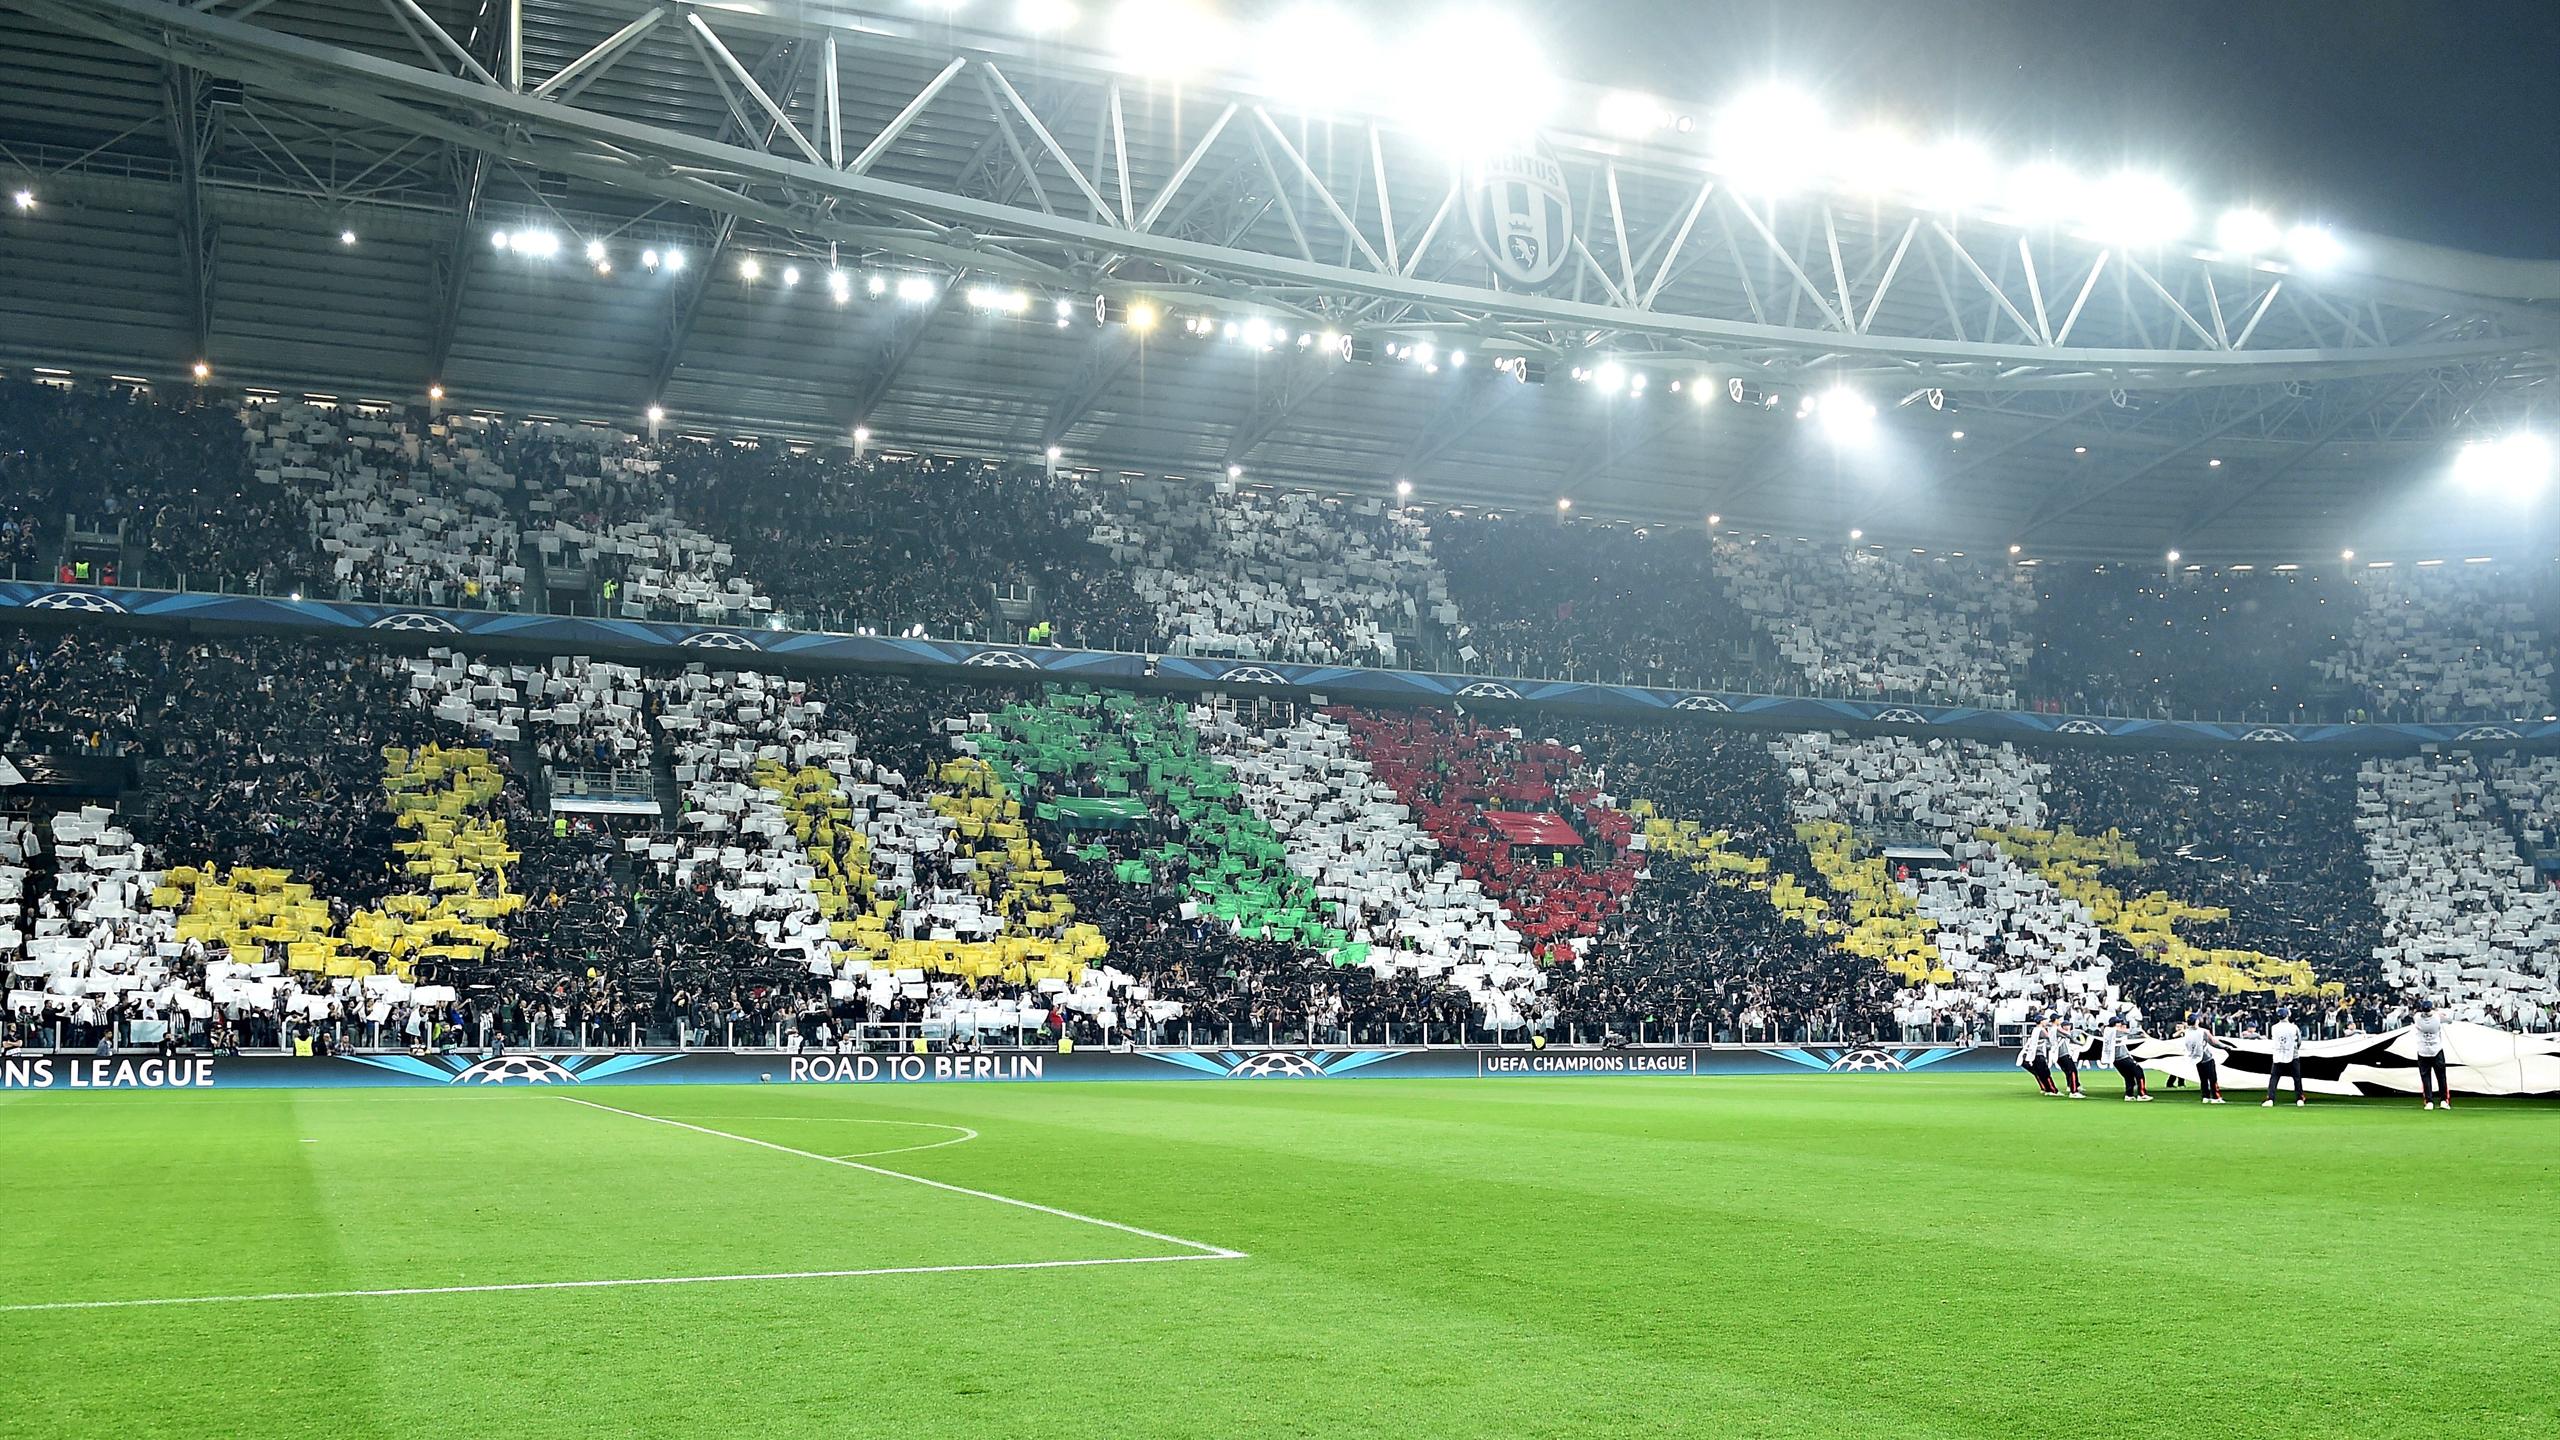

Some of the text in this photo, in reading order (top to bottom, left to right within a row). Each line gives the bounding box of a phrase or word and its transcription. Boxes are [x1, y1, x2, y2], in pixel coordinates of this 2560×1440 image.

[1482, 153, 1560, 187] VENTUS
[0, 1059, 215, 1087] NS LEAGUE
[790, 1056, 1043, 1082] ROAD TO BERLIN
[1487, 1056, 1687, 1071] UEFA CHAMPIONS LEAGUE
